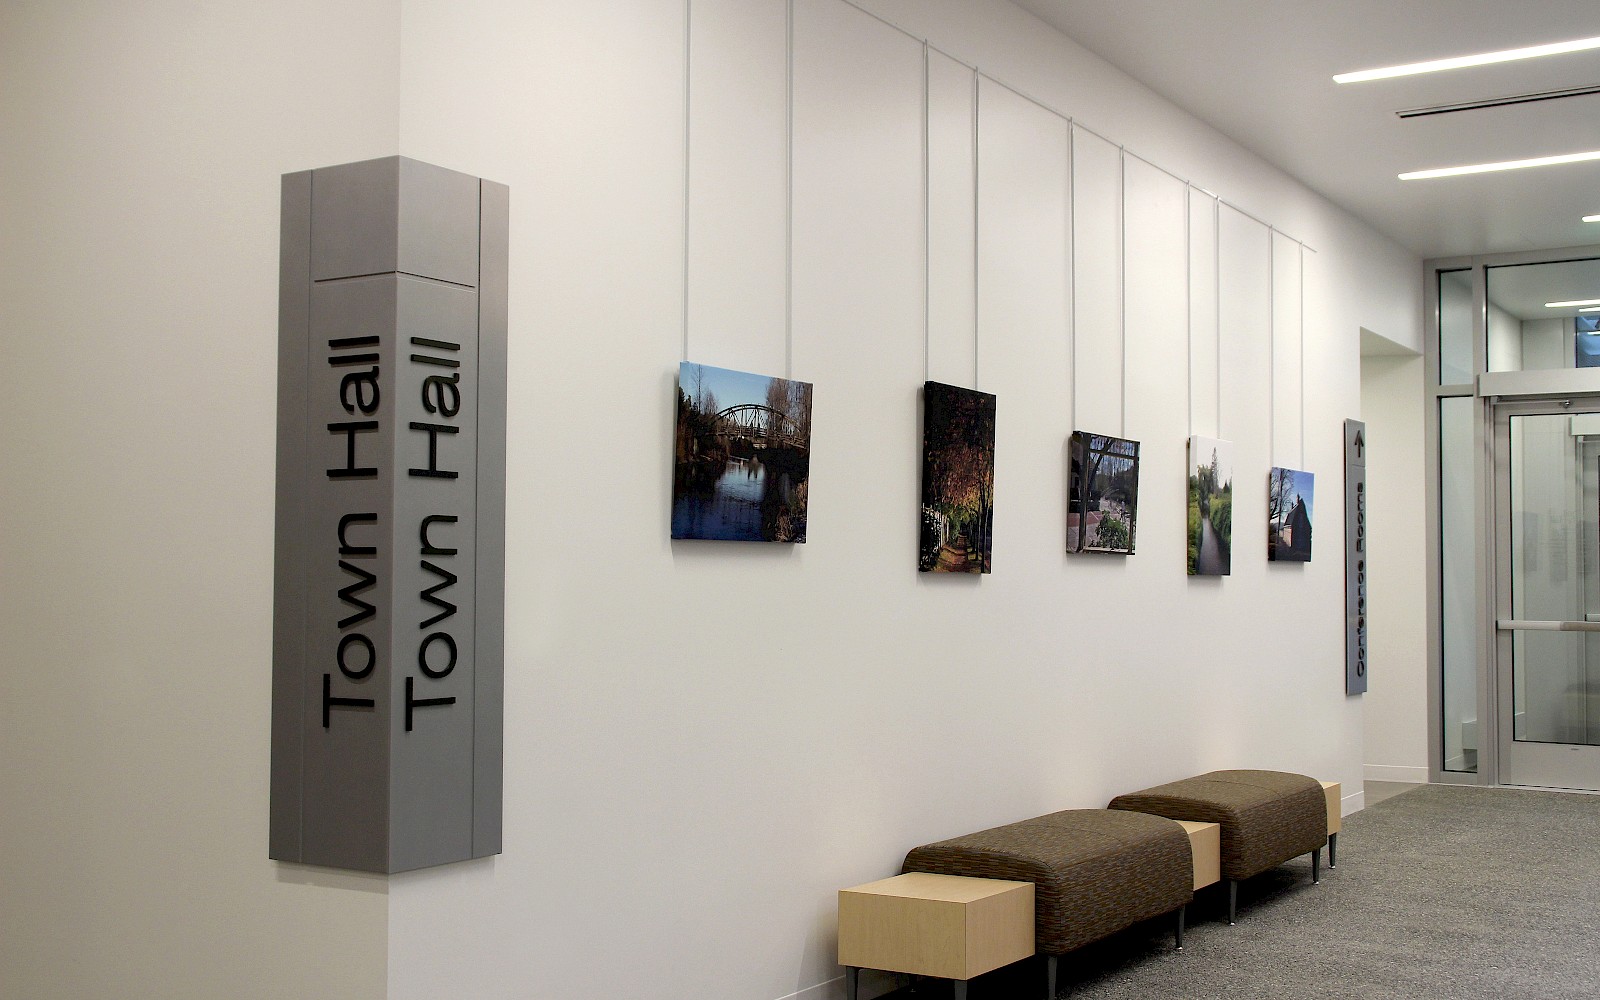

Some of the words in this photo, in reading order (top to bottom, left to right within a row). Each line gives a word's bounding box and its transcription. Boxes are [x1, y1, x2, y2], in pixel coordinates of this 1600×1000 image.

[326, 335, 380, 480] Hall
[408, 336, 461, 480] Hall
[1355, 481, 1364, 553] Rooms
[322, 512, 378, 731] Town
[405, 513, 459, 732] Town
[1356, 559, 1365, 678] Conference
